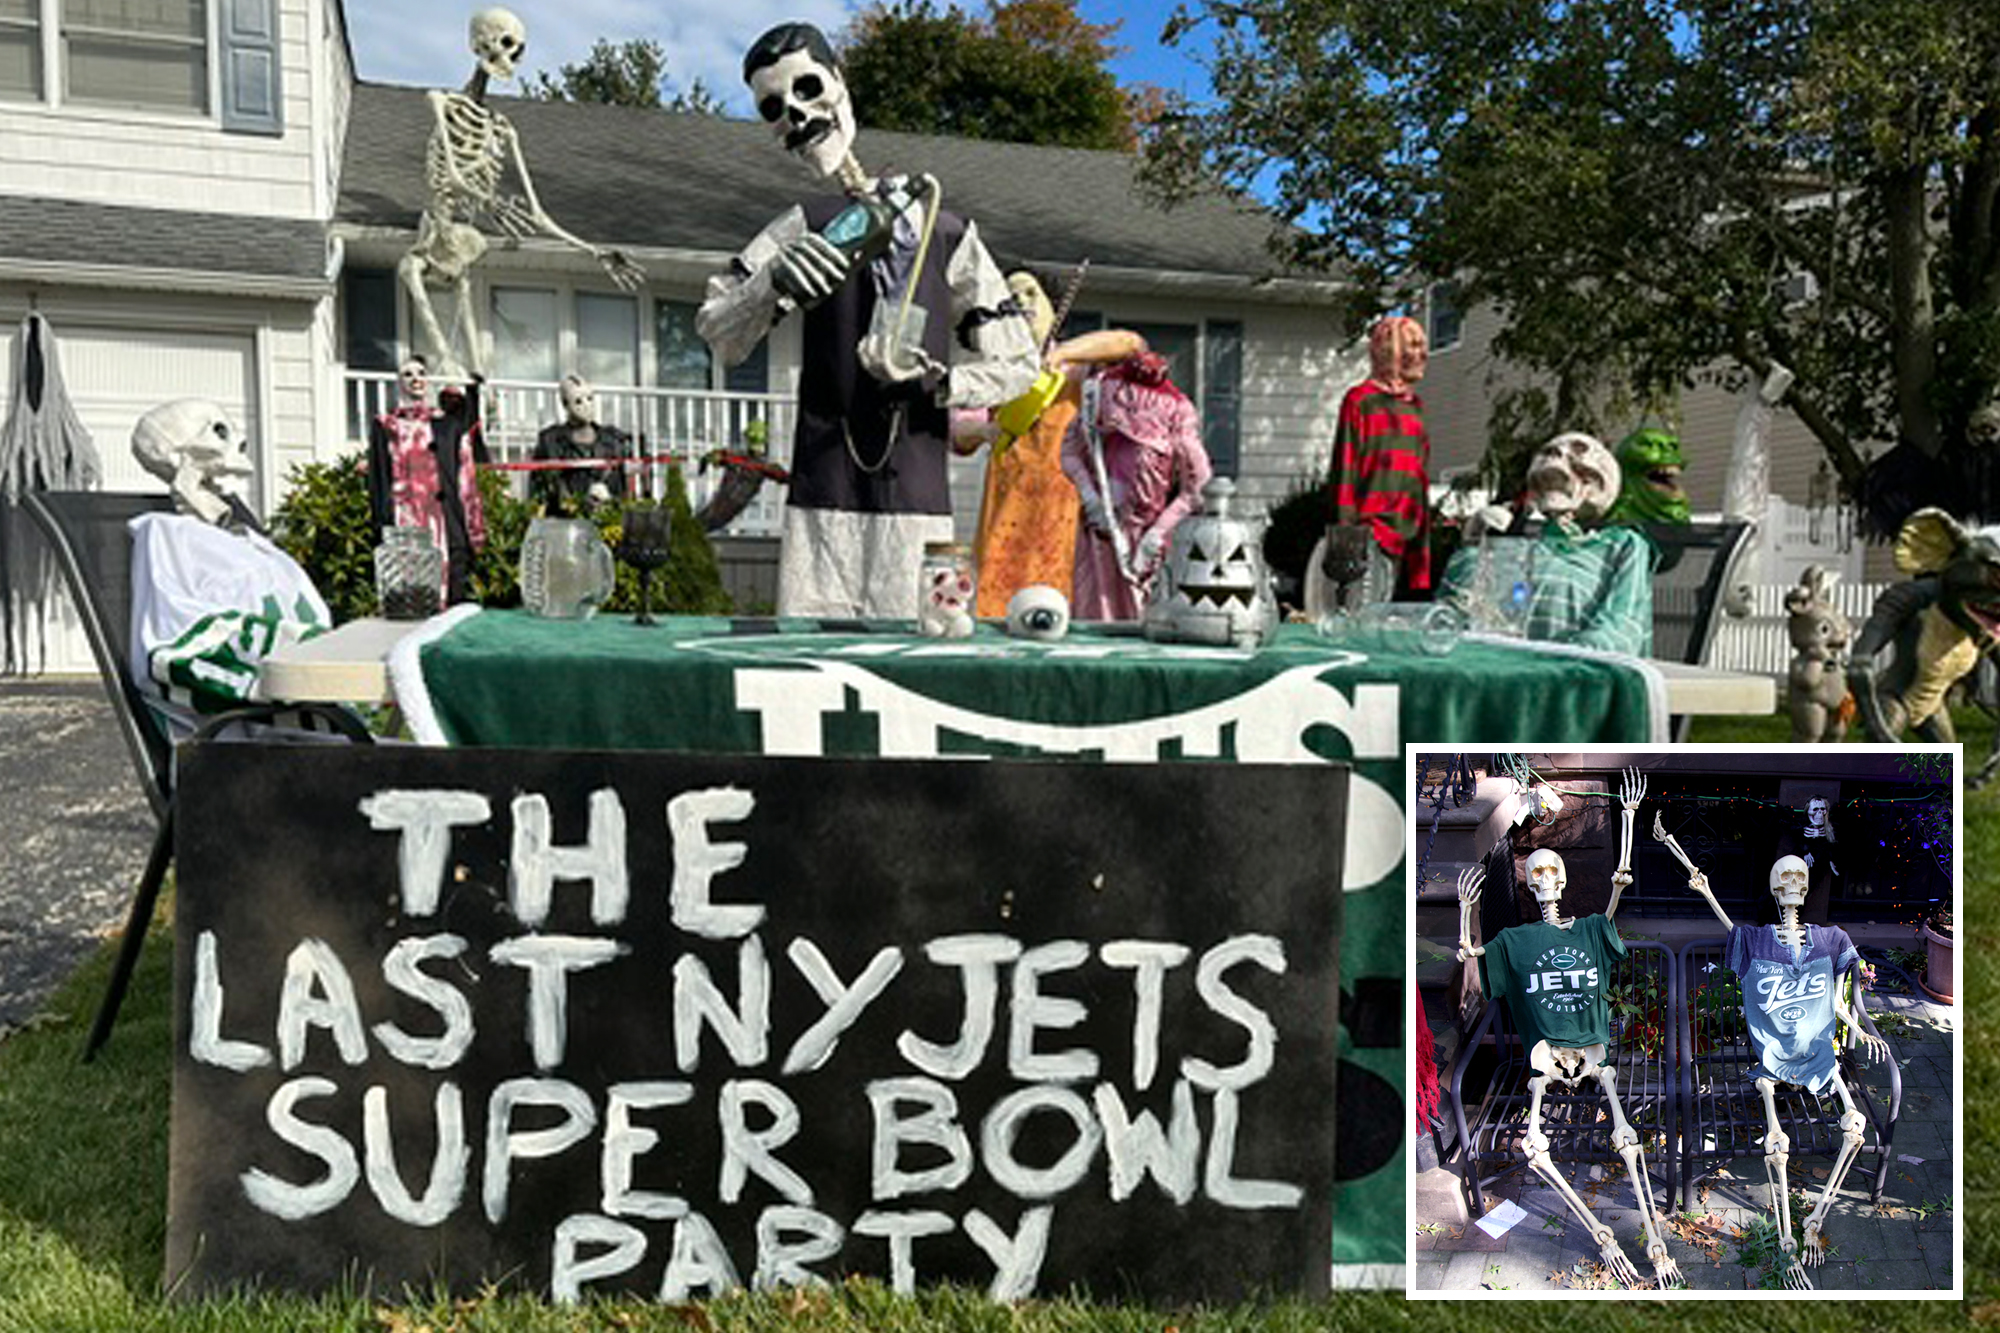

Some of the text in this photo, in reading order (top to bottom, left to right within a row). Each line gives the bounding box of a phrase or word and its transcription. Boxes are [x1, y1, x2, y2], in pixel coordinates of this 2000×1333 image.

[358, 785, 767, 939] THE
[1536, 947, 1590, 967] NEW YORK
[1756, 963, 1784, 975] New York
[1526, 967, 1598, 993] JETS
[1757, 972, 1826, 1014] Jets
[190, 930, 632, 1073] LAST
[671, 933, 904, 1075] NY
[897, 933, 1288, 1090] JETS
[1540, 994, 1595, 1012] FOOTBALL
[240, 1076, 814, 1226] SUPER
[865, 1076, 1304, 1208] BOWL
[552, 1206, 1054, 1303] PARTY
